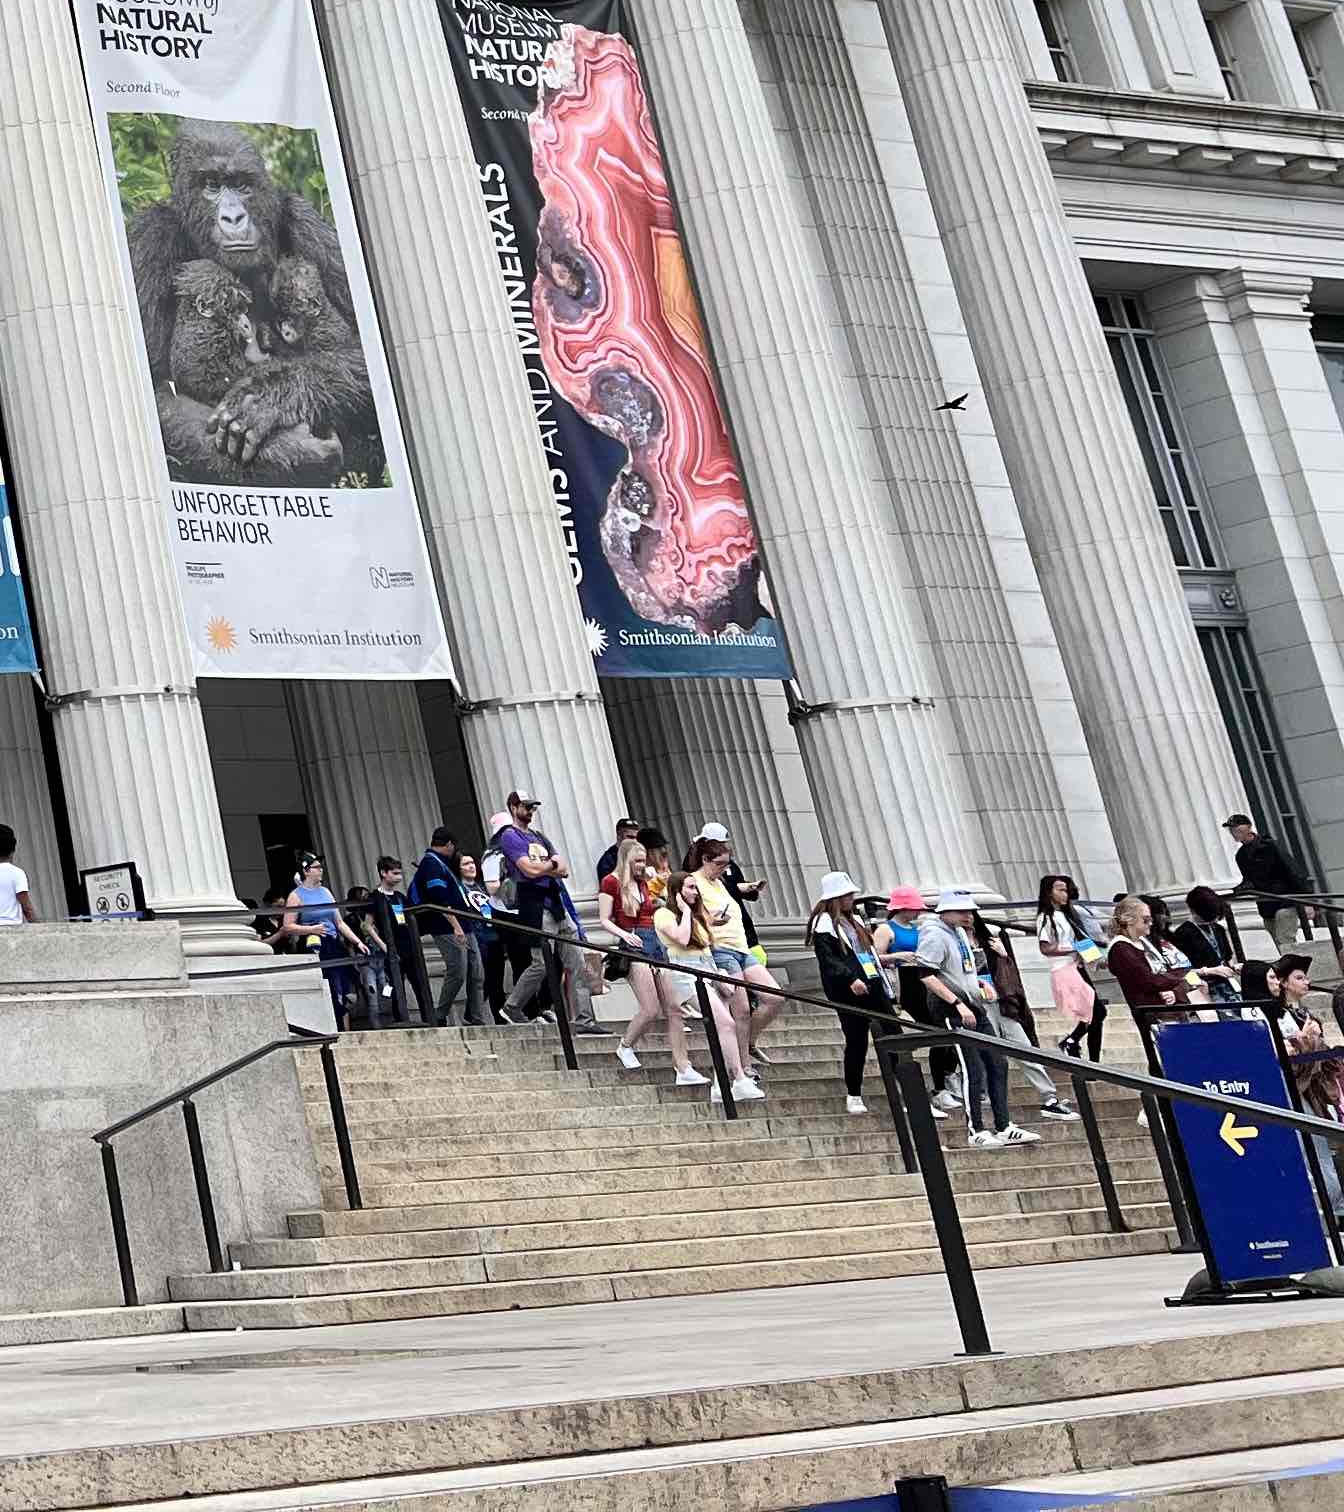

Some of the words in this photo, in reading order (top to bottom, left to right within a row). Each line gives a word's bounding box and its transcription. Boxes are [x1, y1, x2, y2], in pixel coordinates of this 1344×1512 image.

[96, 3, 213, 35] NATURAL
[455, 12, 559, 39] MUSEUM
[100, 29, 203, 60] HISTORY
[464, 33, 564, 64] NATURA
[106, 80, 151, 94] Second
[478, 162, 541, 355] MINERALS
[527, 368, 563, 456] AND
[172, 490, 334, 518] UNFORGETTABLE
[177, 518, 273, 545] BEHAVIOR
[248, 628, 341, 646] Smithsonian
[344, 630, 422, 646] Institution
[618, 628, 711, 647] Smithsonian
[713, 630, 777, 648] Institution
[1202, 1081, 1218, 1094] To
[1219, 1080, 1250, 1095] Entry
